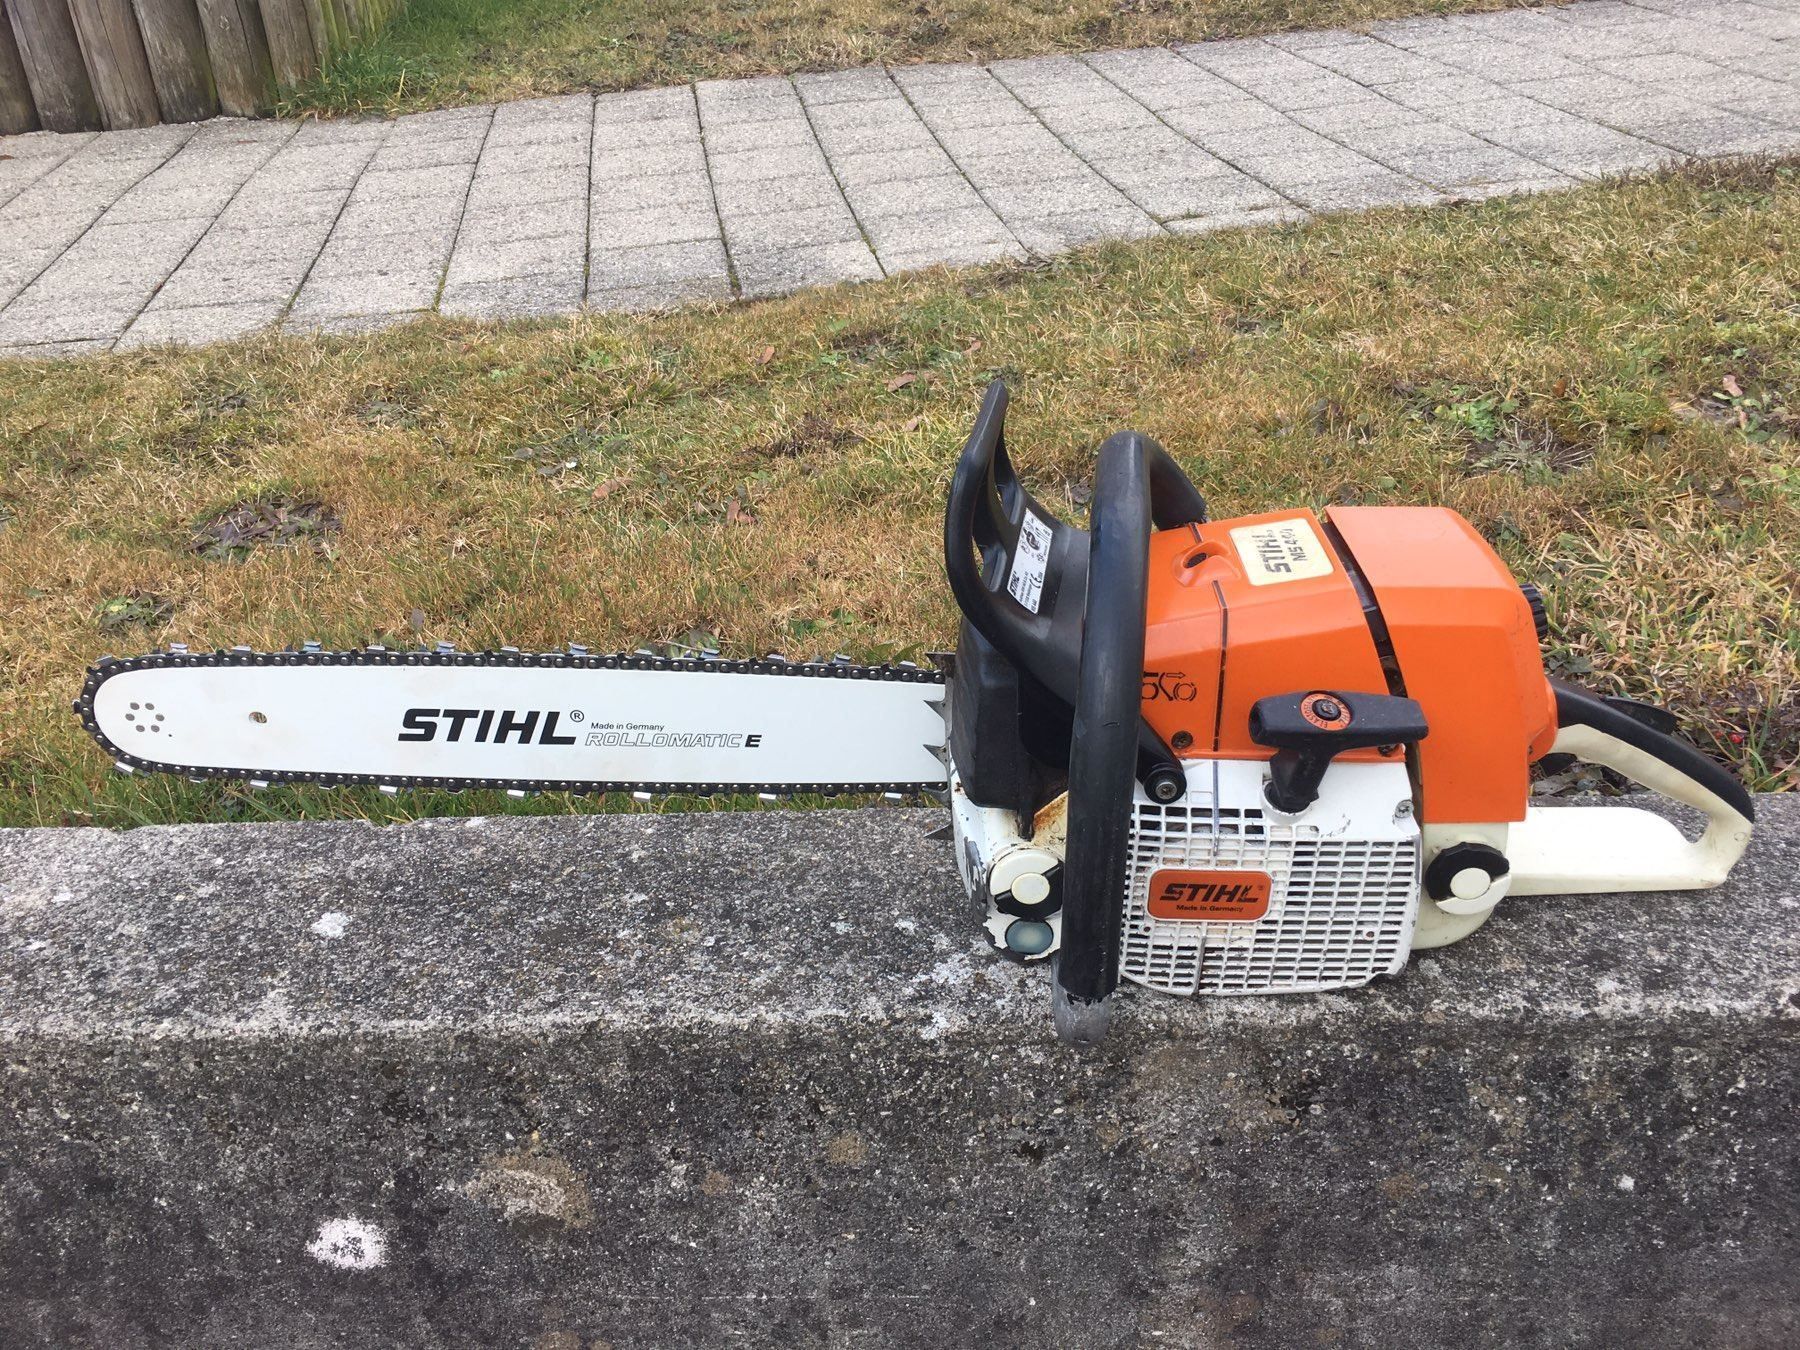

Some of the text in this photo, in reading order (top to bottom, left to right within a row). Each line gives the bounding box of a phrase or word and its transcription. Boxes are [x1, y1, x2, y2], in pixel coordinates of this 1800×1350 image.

[1251, 529, 1292, 573] STIHL
[1288, 546, 1308, 561] MS
[398, 708, 577, 745] STIHL
[591, 722, 665, 732] Made in Germany
[585, 732, 762, 748] ROLLOMATIC E
[1160, 883, 1259, 903] STIHL
[1199, 904, 1207, 912] in
[1209, 904, 1244, 913] Germany
